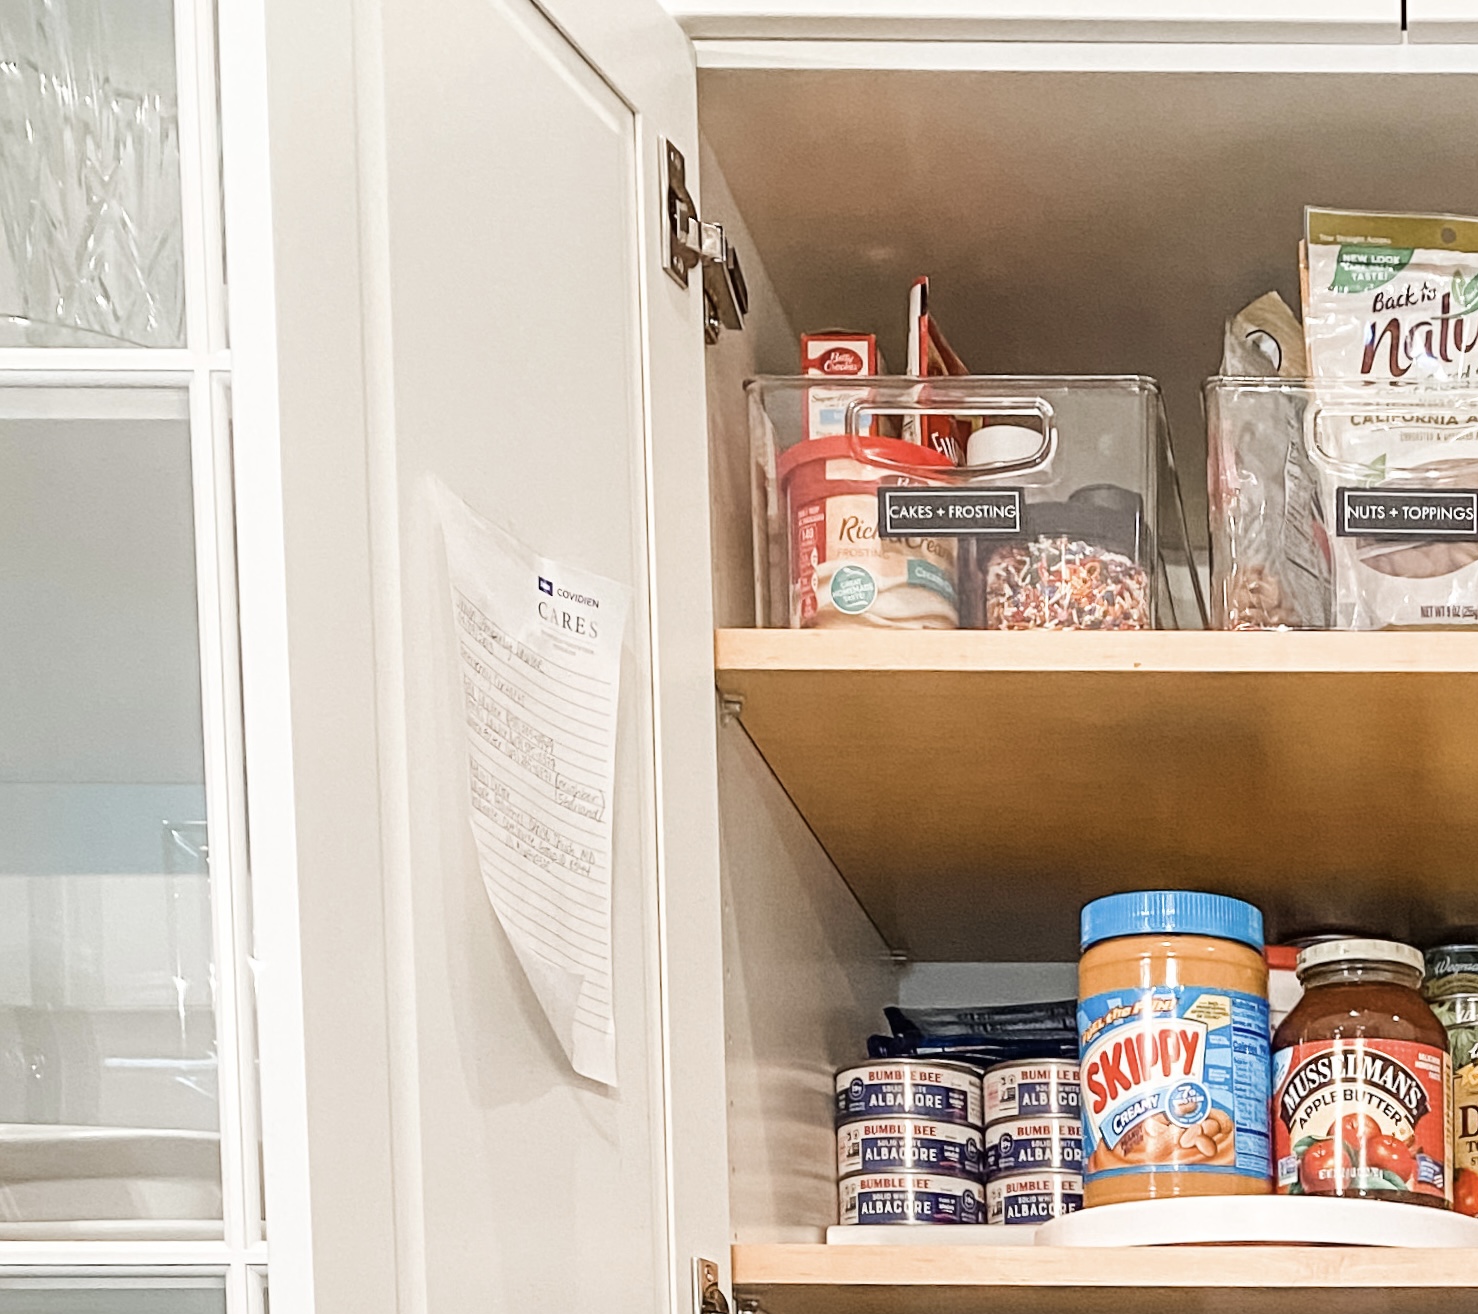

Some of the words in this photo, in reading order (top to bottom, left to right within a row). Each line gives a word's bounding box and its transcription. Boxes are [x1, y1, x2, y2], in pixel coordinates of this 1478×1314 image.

[1342, 253, 1369, 263] NEW
[1372, 254, 1401, 264] LOOK
[1372, 284, 1418, 313] Back
[889, 505, 933, 519] CAKES
[936, 506, 946, 518] +
[948, 504, 1017, 519] FROSTING
[1347, 505, 1386, 520] NUTS
[1388, 507, 1400, 519] +
[1402, 505, 1475, 521] TOPPINGS
[556, 588, 600, 608] COVIDIEN
[537, 600, 599, 639] CARES
[868, 1070, 917, 1081] BUMBE
[919, 1072, 943, 1083] BEE
[1021, 1070, 1069, 1081] BUMLE
[1086, 1028, 1200, 1116] SKIPPY
[1282, 1053, 1423, 1116] MUSSELMAN'S
[868, 1093, 943, 1109] ALBAORE
[1111, 1093, 1161, 1136] CREAMY
[1299, 1090, 1338, 1131] APPLE
[1342, 1088, 1403, 1127] BUTTER
[864, 1124, 911, 1136] BUMBL
[914, 1125, 937, 1137] BEE
[1017, 1125, 1066, 1137] BUMBE
[859, 1179, 907, 1190] BUMBLE
[909, 1179, 931, 1190] EE
[1005, 1180, 1050, 1192] BUMBLE
[1054, 1180, 1076, 1191] EE
